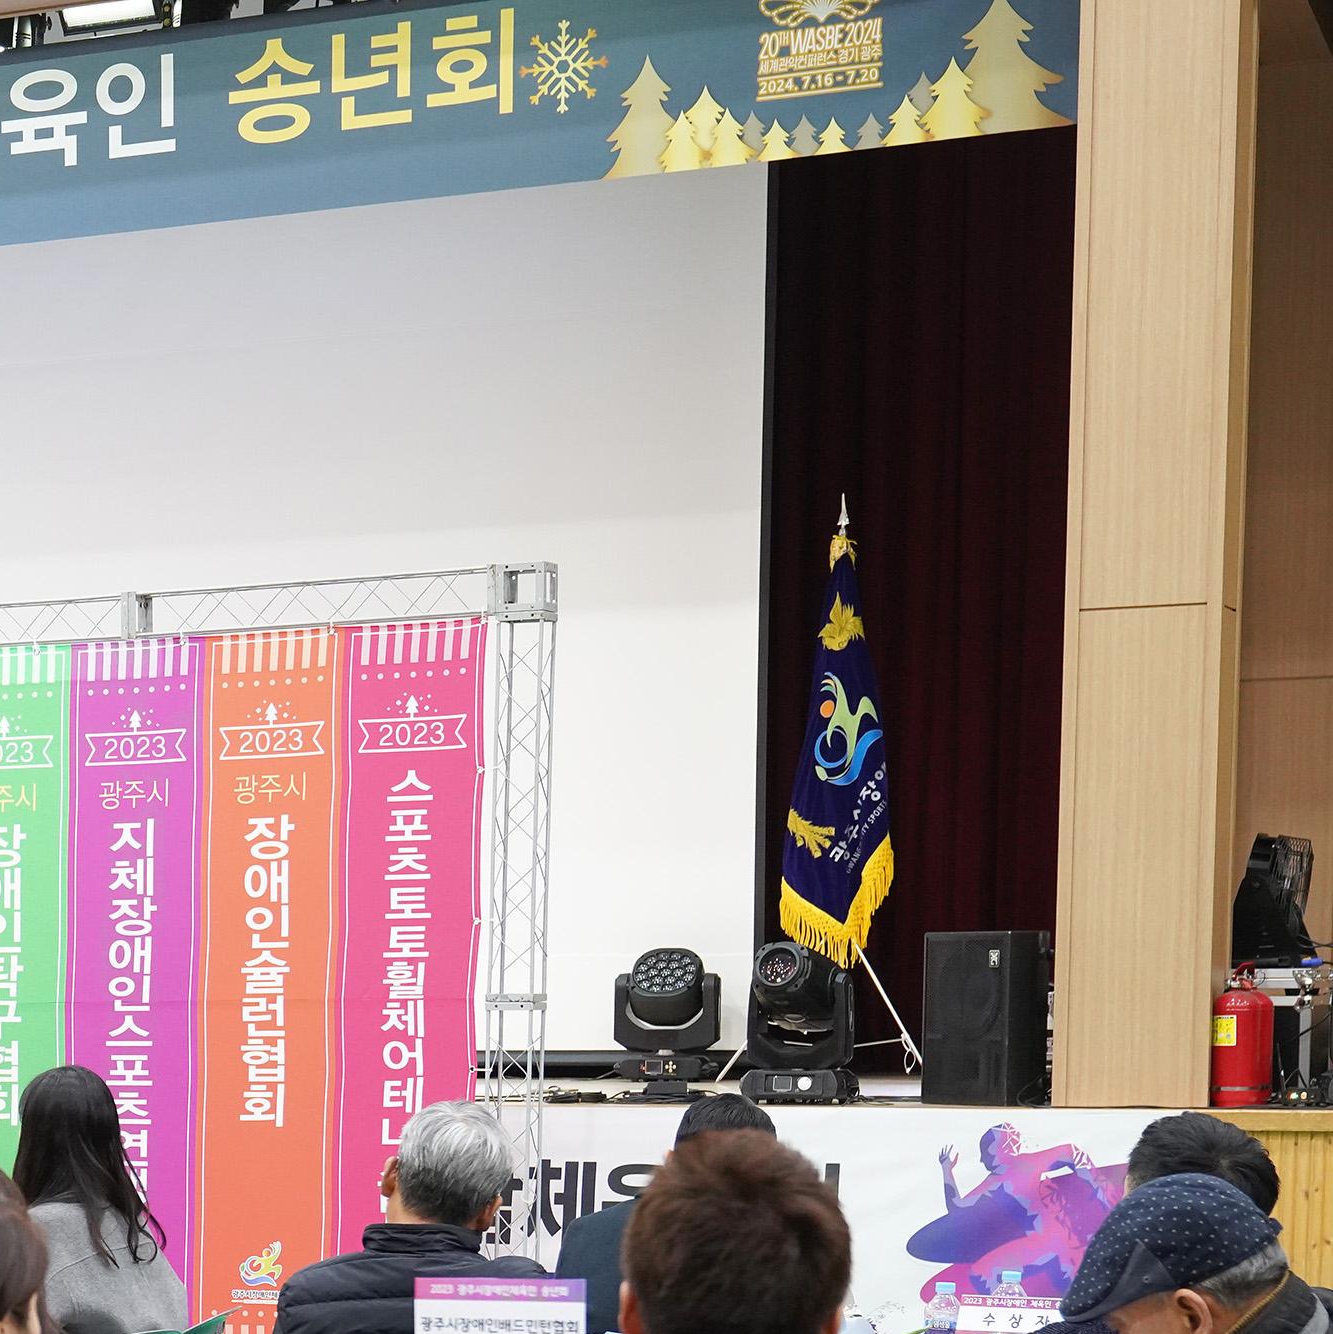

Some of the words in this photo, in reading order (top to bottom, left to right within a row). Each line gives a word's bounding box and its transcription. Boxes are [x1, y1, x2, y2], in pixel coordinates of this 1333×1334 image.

[789, 23, 844, 55] WASBE
[844, 16, 882, 47] 2024
[838, 48, 859, 64] 경기
[860, 44, 883, 61] 광주
[228, 7, 515, 145] 송년회
[758, 78, 799, 95] 2024.
[801, 72, 834, 90] 7.16
[846, 67, 879, 85] 7.20
[104, 735, 167, 760] 2023
[238, 728, 304, 753] 2023
[378, 722, 445, 747] 2023
[98, 778, 170, 810] 광주시
[233, 770, 308, 805] 광주시
[238, 814, 295, 1128] 장애인슐런협회
[964, 1296, 983, 1305] 2023
[986, 1297, 1027, 1308] 광주시장애인
